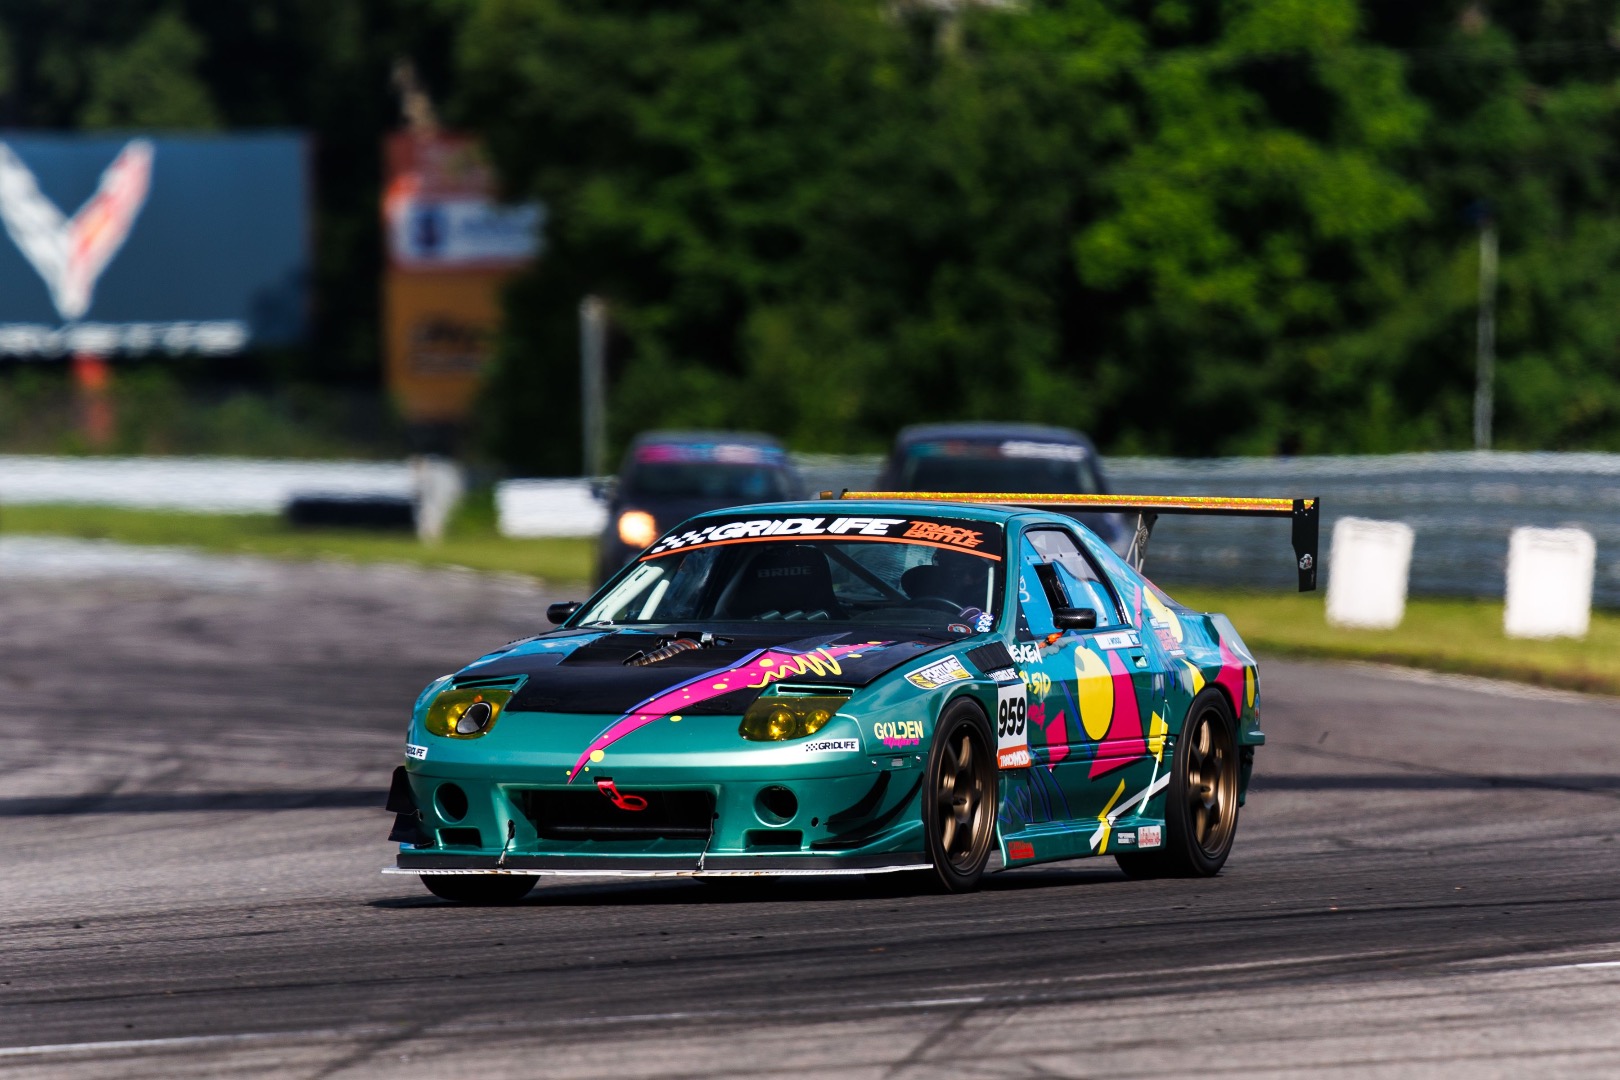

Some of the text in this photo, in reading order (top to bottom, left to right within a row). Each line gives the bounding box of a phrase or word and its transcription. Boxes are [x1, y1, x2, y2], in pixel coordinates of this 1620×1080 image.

[708, 517, 906, 536] GRIDLIFE
[905, 520, 984, 539] TRACK
[901, 529, 984, 548] BATTLE
[757, 565, 814, 578] BRIDE
[998, 697, 1026, 739] 959
[873, 720, 925, 740] GOLDEN
[818, 741, 856, 750] GRIDLIFE
